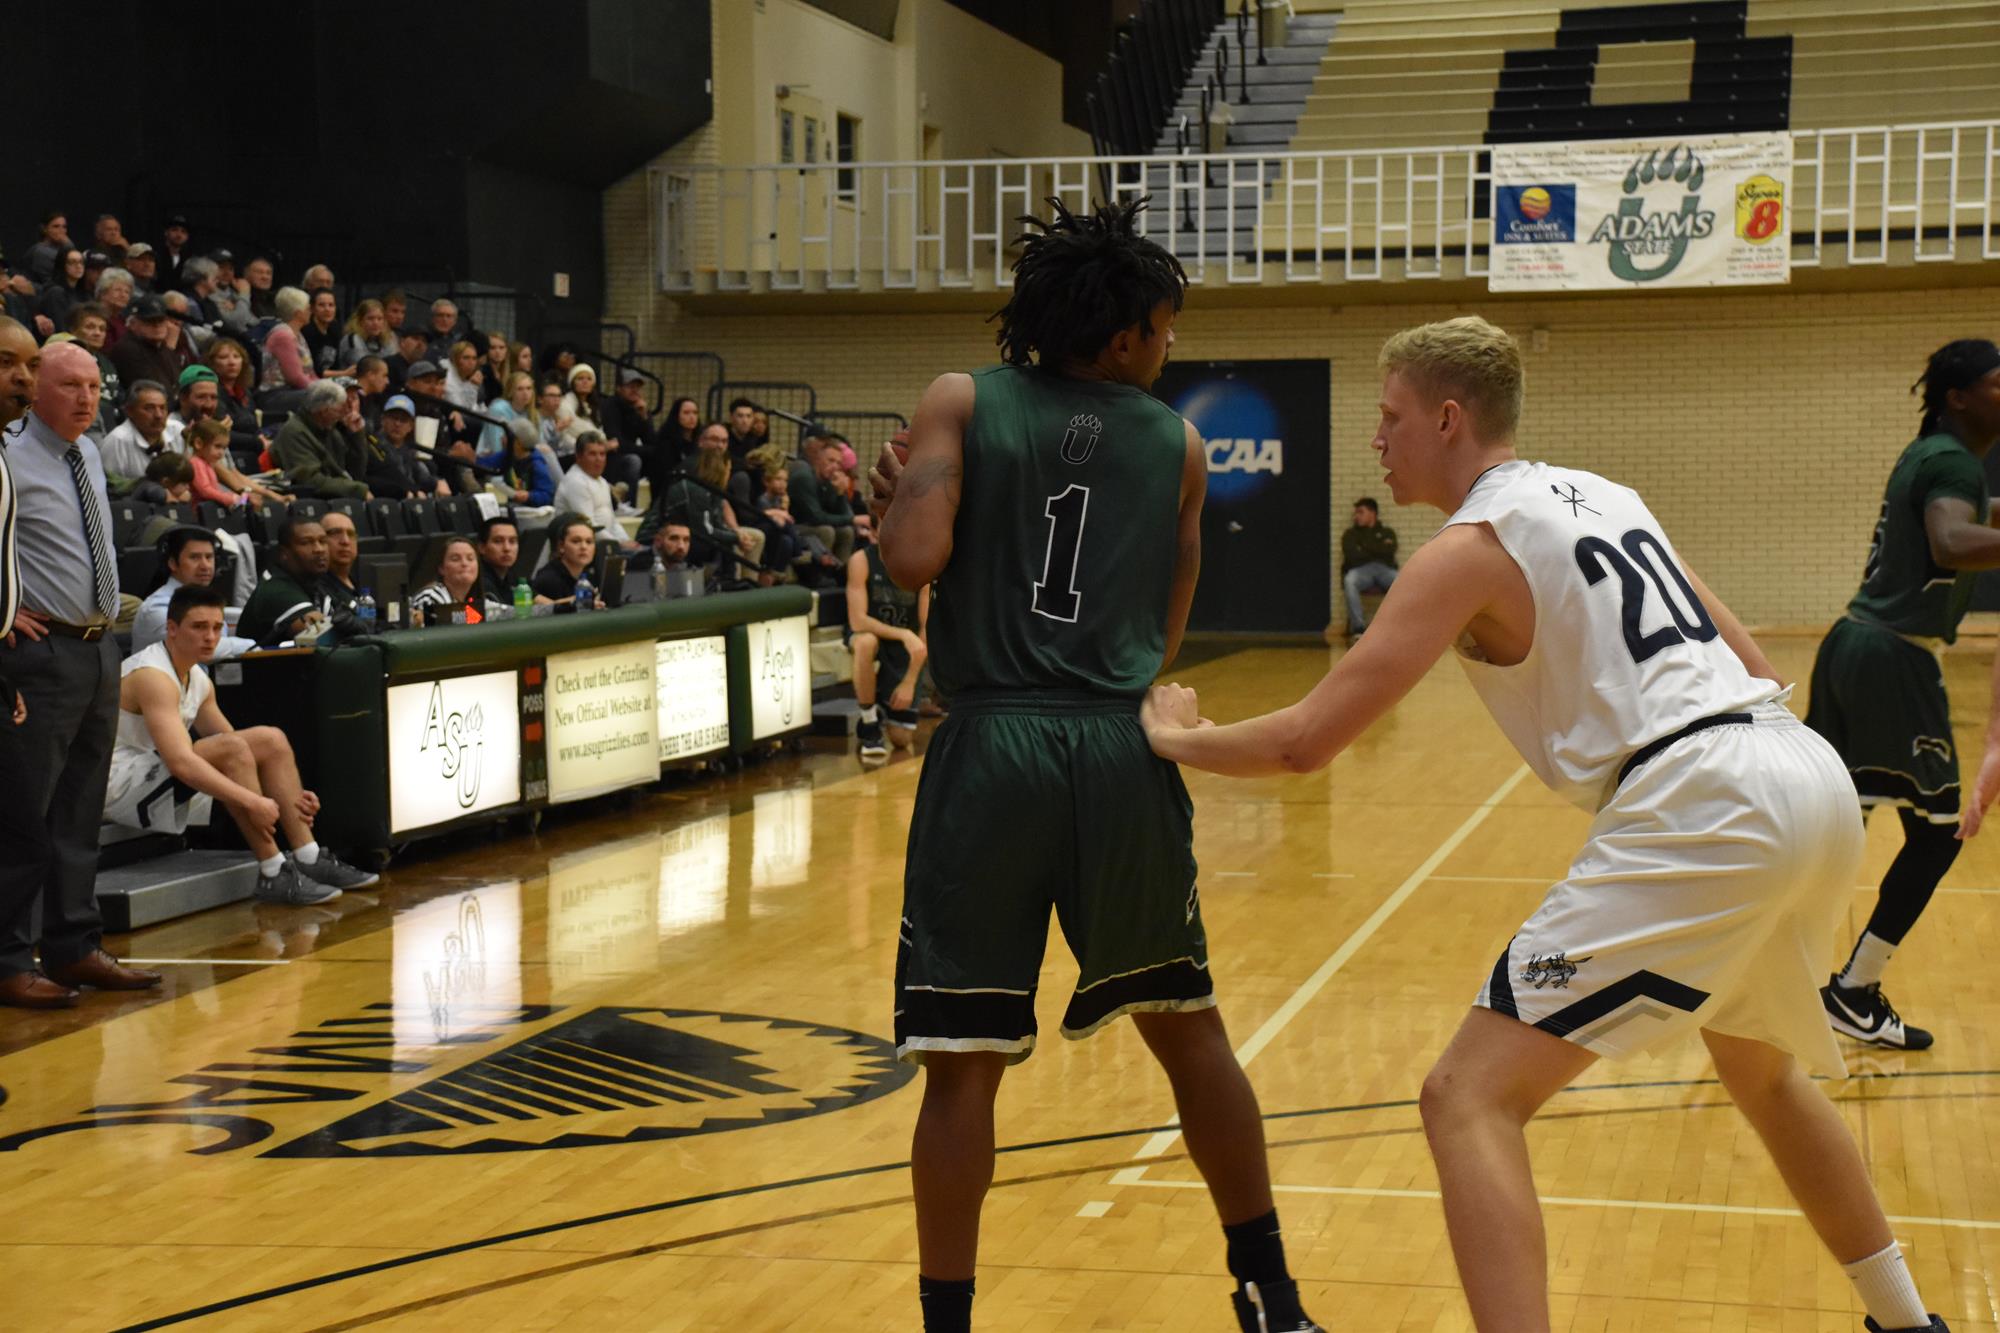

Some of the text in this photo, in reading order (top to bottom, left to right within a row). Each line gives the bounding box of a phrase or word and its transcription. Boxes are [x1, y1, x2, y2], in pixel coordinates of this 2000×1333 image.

[1510, 219, 1559, 232] Comfort
[1588, 211, 1715, 244] ADAMS
[1745, 199, 1780, 239] 8
[1622, 238, 1674, 255] STATE
[1203, 438, 1282, 475] CAA
[1031, 484, 1090, 623] 1
[1575, 528, 1719, 665] 20
[556, 663, 649, 694] Check out the Grizzlies
[523, 694, 544, 714] POSS
[555, 693, 652, 727] New Official Website at
[559, 730, 649, 759] www.asugrizzlies.com
